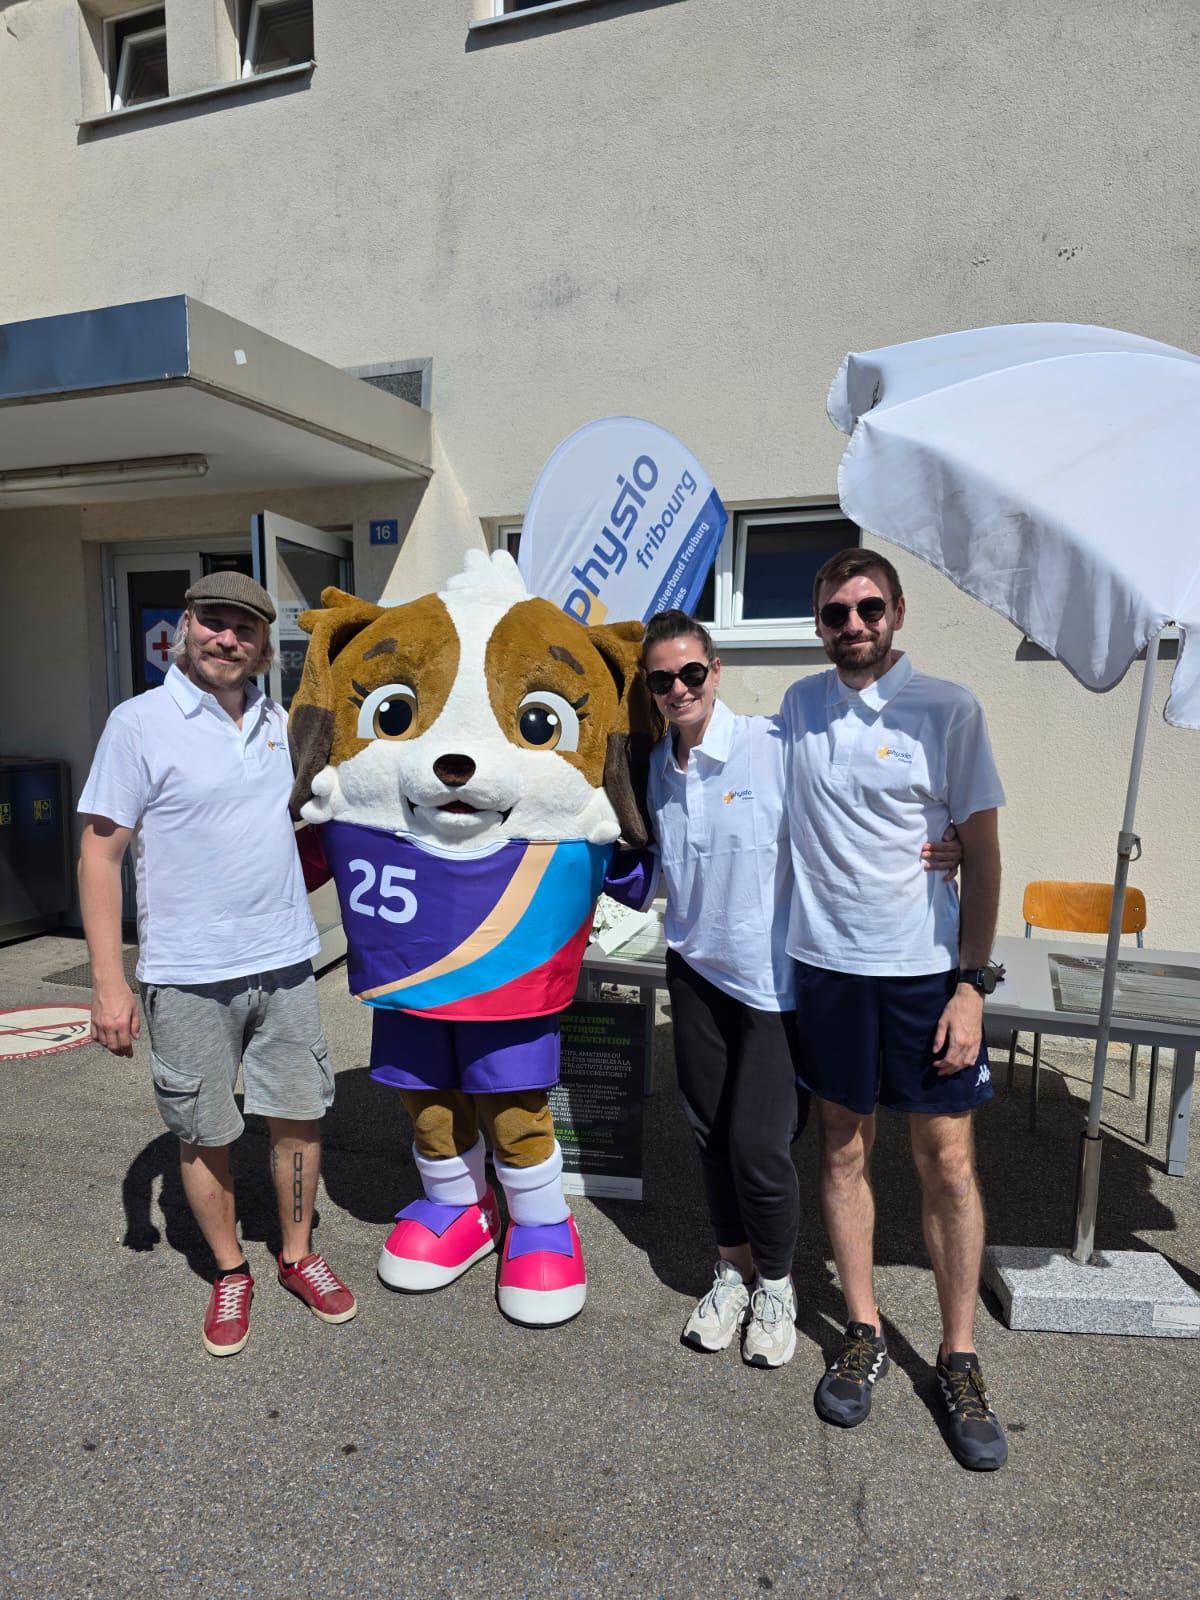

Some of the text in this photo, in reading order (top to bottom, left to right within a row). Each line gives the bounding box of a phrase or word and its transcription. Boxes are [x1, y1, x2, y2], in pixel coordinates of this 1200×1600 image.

[375, 525, 391, 540] 16
[562, 455, 658, 626] physio
[635, 469, 697, 570] fribourg
[655, 522, 710, 614] nalverband Freiburg
[671, 587, 687, 609] wiss
[348, 859, 418, 923] 25
